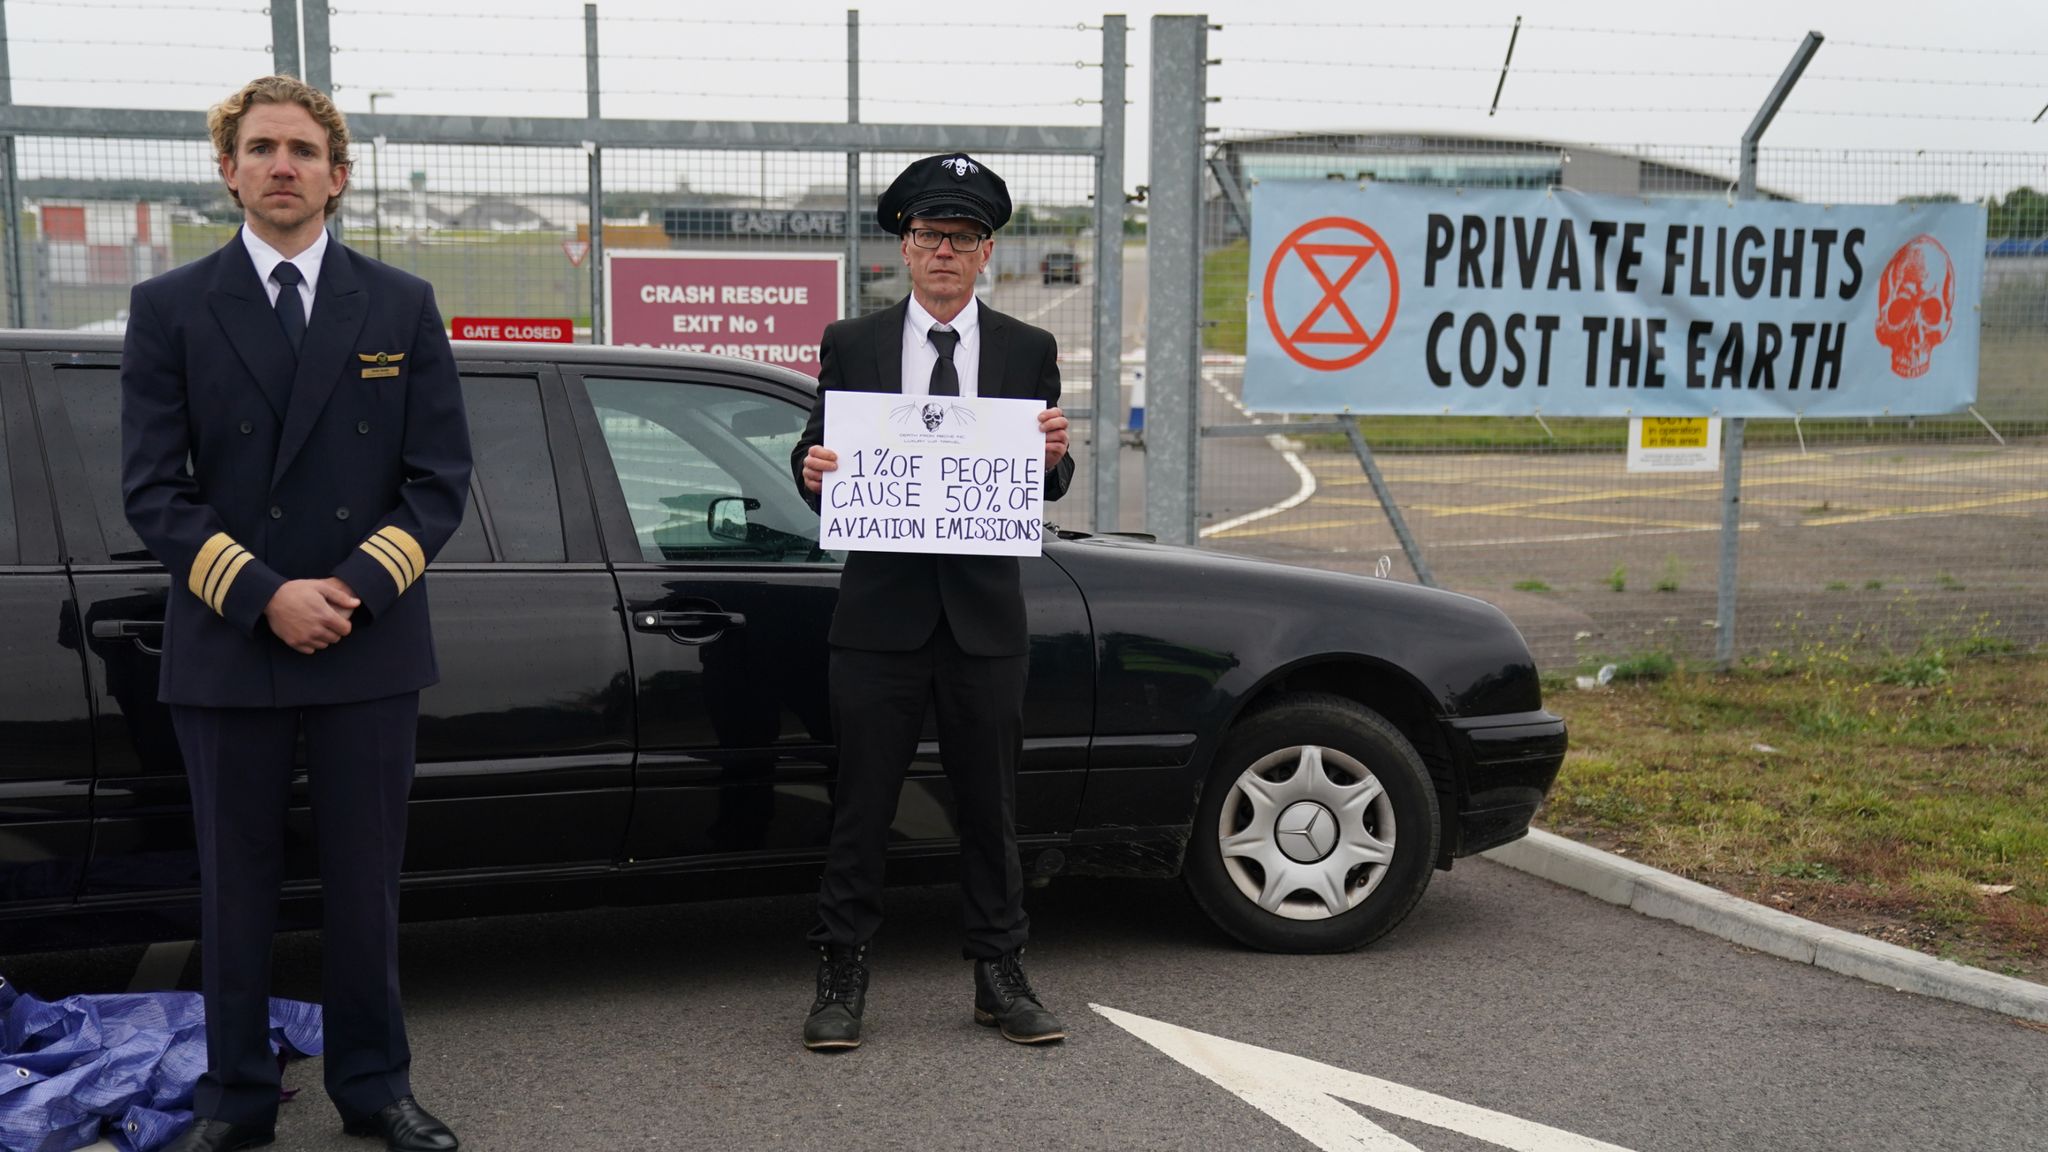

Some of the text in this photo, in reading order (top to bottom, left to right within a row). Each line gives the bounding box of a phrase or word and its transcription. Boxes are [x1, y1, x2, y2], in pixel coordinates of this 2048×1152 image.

[731, 210, 844, 234] EAST GATE
[1424, 213, 1866, 300] PRIVATE FLIGHTS
[641, 285, 808, 305] CRASH RESCUE
[463, 325, 562, 340] GATE CLOSED
[672, 315, 775, 333] EXIT No 1
[1425, 311, 1847, 391] COST THE EARTH
[1659, 427, 1702, 437] operation
[1660, 437, 1676, 446] this
[1679, 438, 1700, 446] area
[941, 457, 1039, 485] PEOPLE
[831, 481, 1039, 513] CAUSE 50% OF
[827, 516, 1041, 542] AVIATION EMISSIONS
